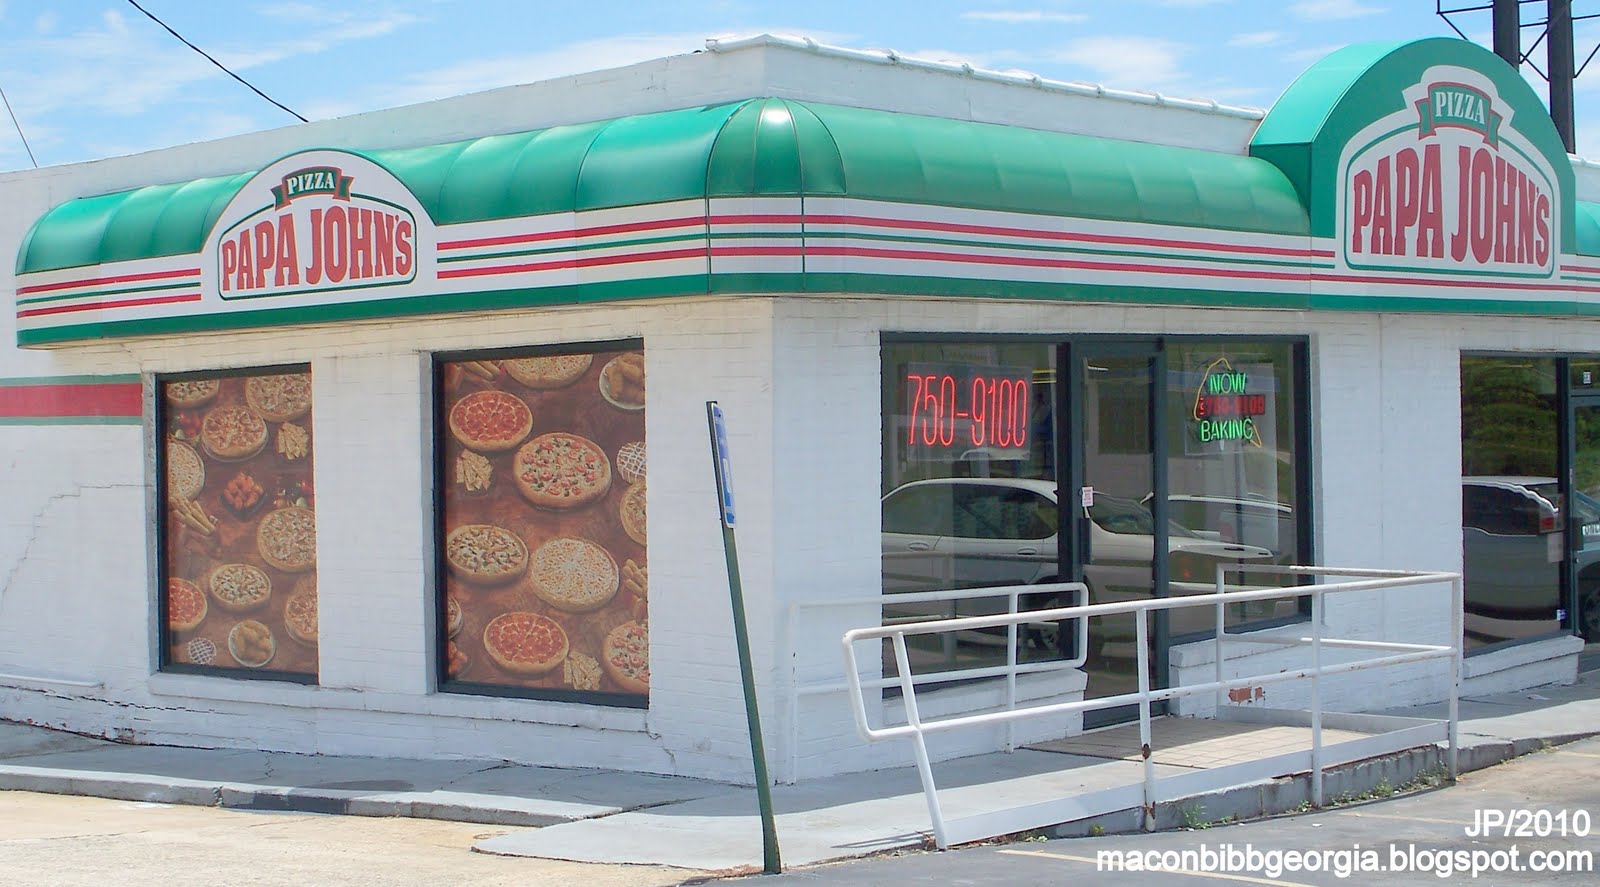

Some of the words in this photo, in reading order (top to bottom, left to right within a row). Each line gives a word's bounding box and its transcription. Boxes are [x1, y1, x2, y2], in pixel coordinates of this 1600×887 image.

[1434, 91, 1485, 125] PIZZA
[286, 171, 336, 196] PIZZA
[1352, 143, 1445, 259] PAPA
[1450, 145, 1550, 267] JOHN'S
[221, 212, 300, 292] PAPA
[305, 205, 413, 286] JOHN'S
[1209, 373, 1247, 395] NOW
[907, 375, 1028, 447] 750-9100
[1200, 418, 1253, 442] BAKING
